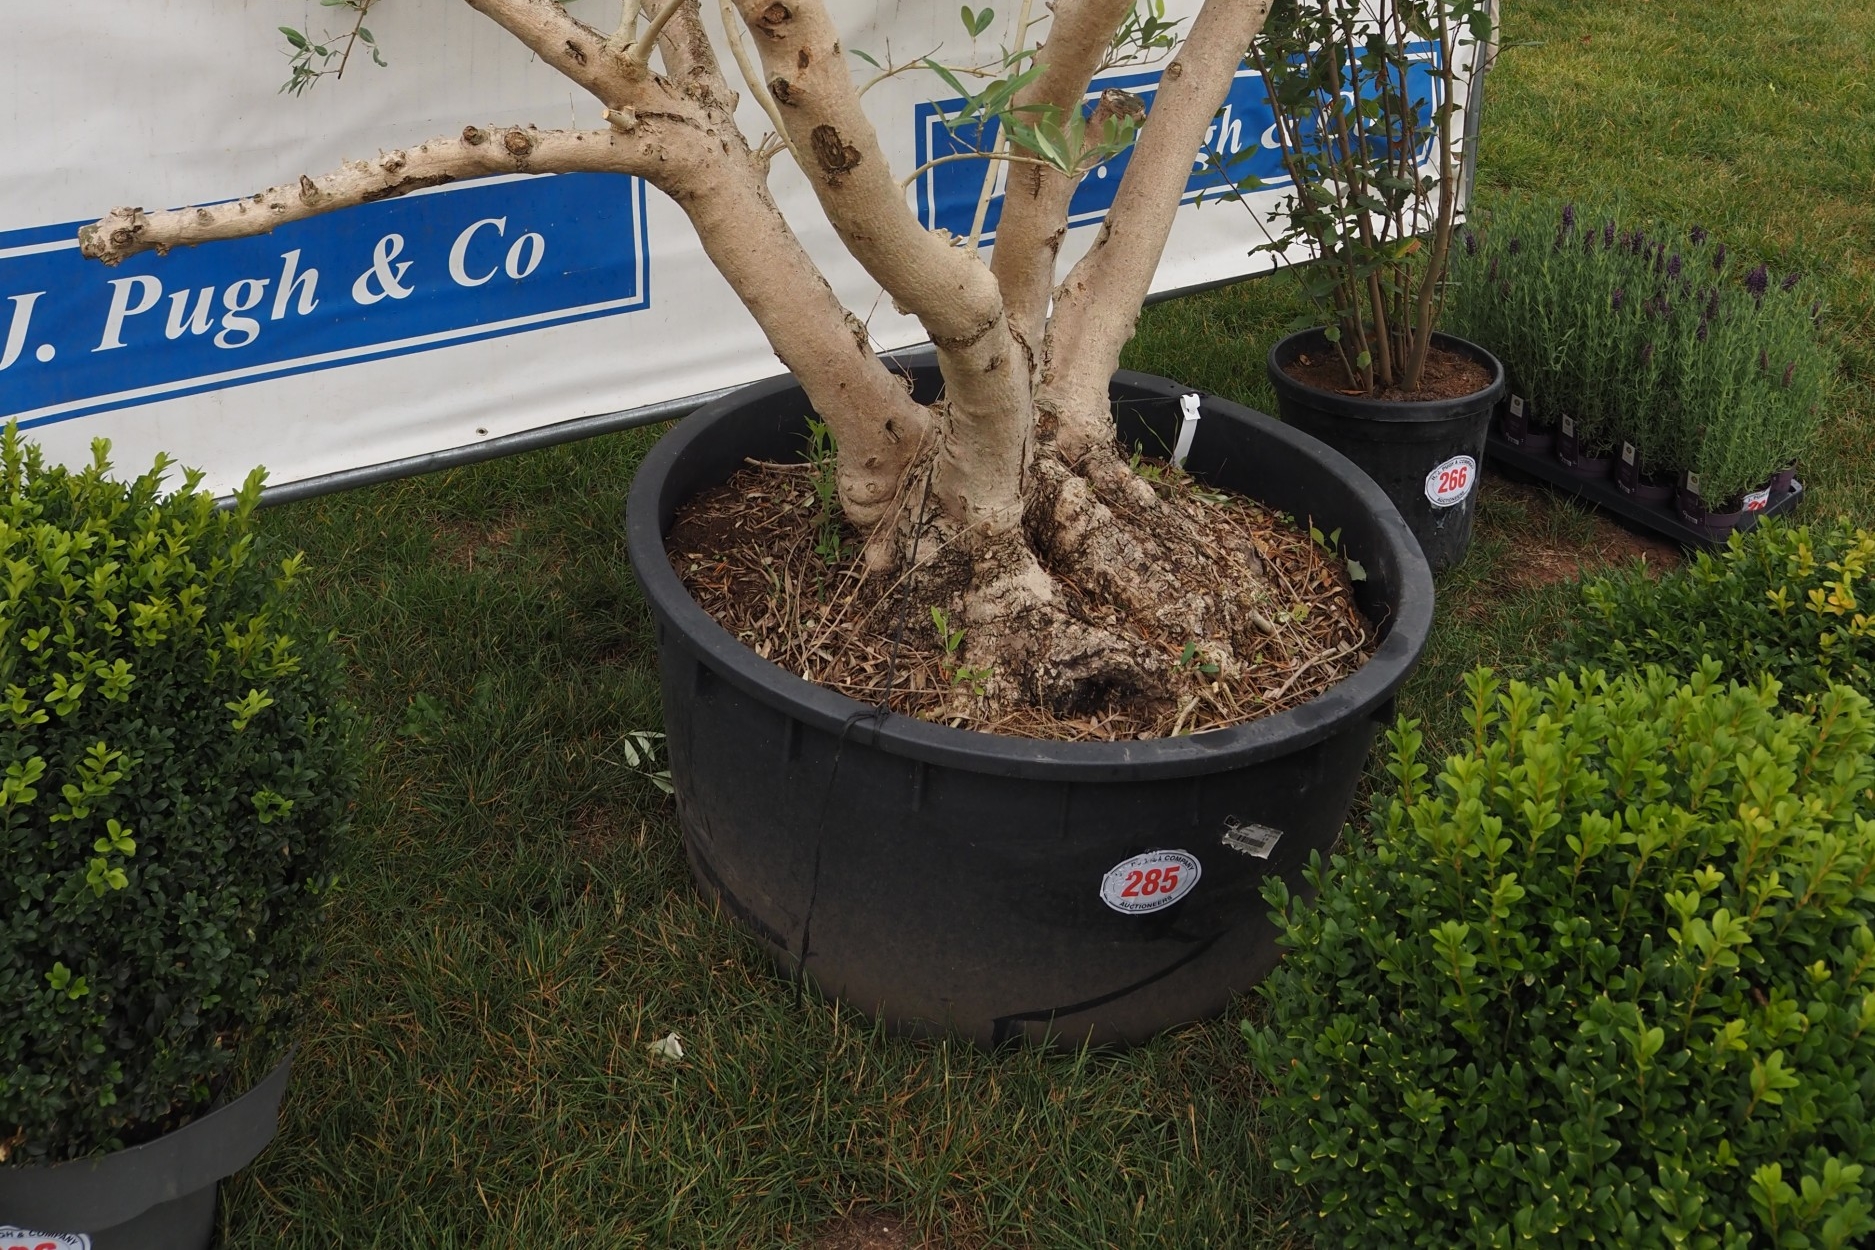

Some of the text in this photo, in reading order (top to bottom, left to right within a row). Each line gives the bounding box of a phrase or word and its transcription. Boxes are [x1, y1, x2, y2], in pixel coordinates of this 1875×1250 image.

[0, 216, 545, 363] J. Pugh & Co
[1437, 466, 1468, 494] 266
[1164, 855, 1195, 871] COMPANY
[1121, 865, 1181, 897] 285
[1119, 895, 1173, 910] AUCTIONEERS
